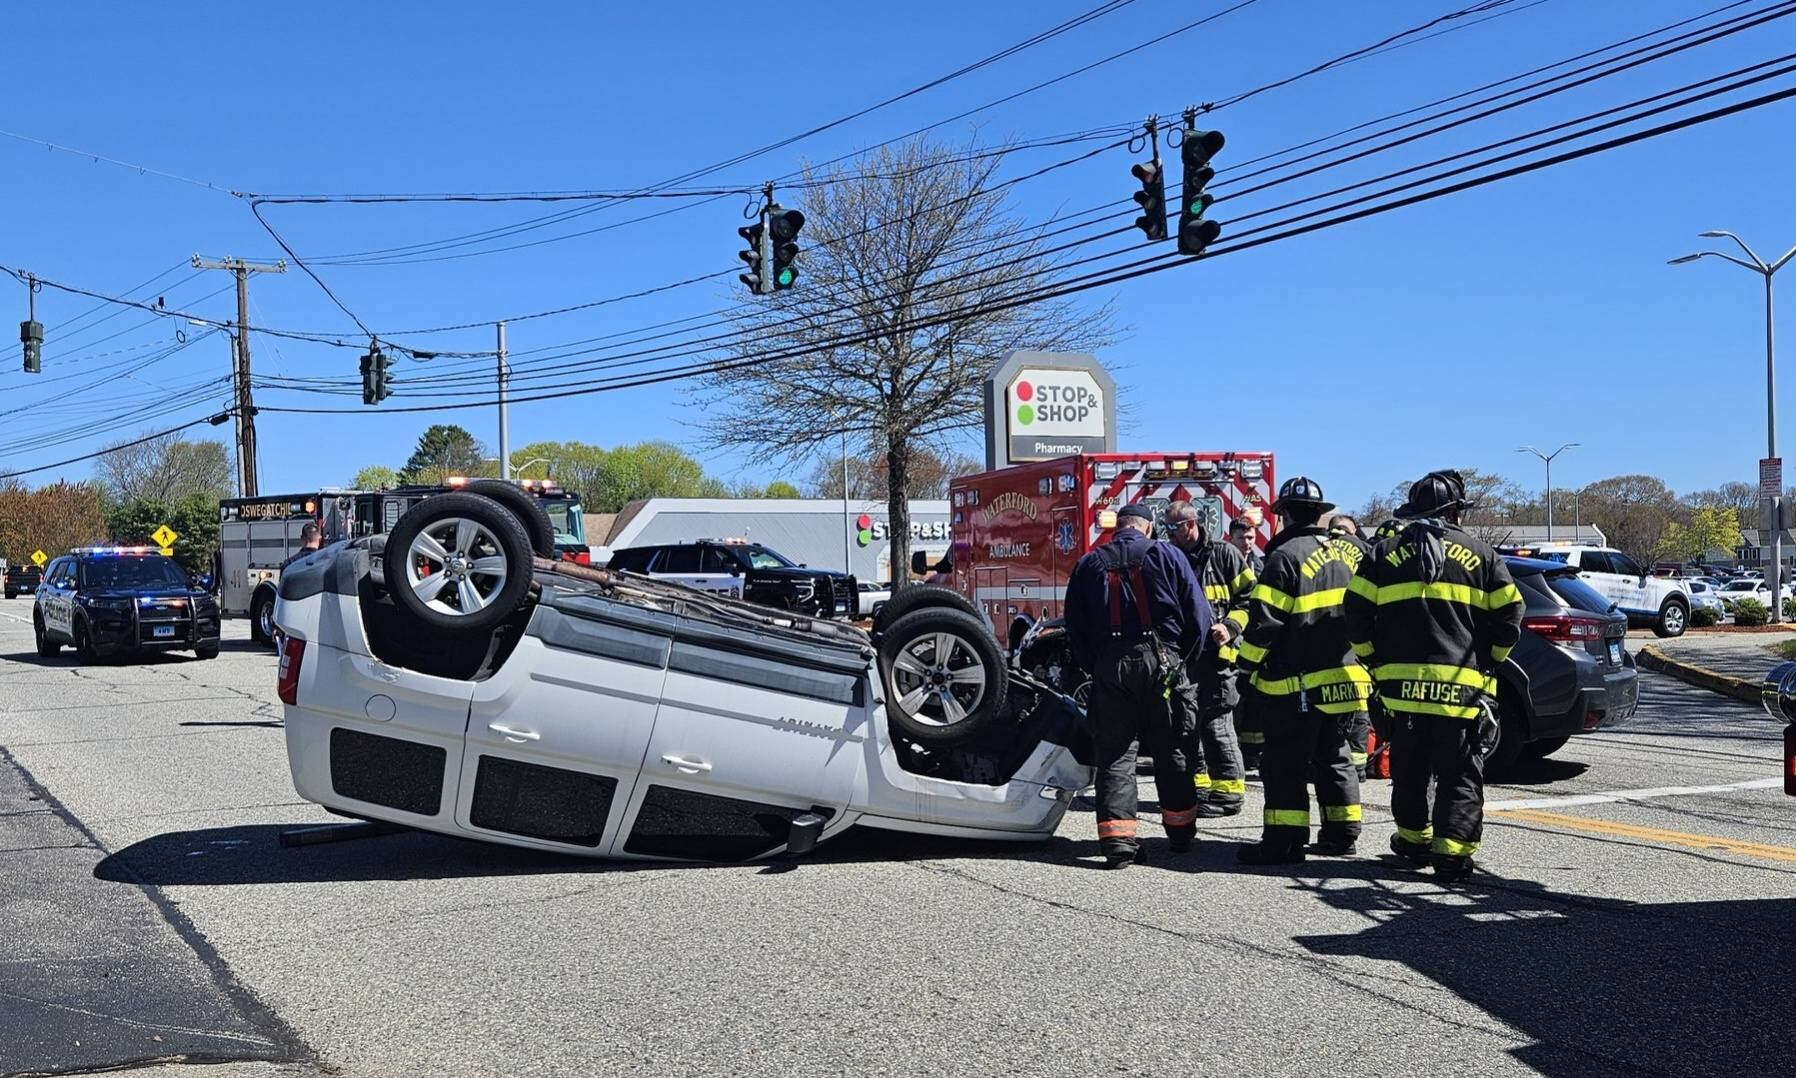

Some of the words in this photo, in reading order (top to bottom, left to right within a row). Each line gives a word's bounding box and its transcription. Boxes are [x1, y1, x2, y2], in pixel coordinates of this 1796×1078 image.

[1036, 385, 1088, 403] STOP
[1087, 393, 1098, 408] &
[1037, 404, 1089, 422] SHOP
[1034, 442, 1083, 454] Pharmacy
[983, 492, 1037, 521] WATERFORD
[989, 543, 1030, 558] AMBULANCE
[1385, 540, 1481, 572] WATFORD
[1401, 681, 1462, 704] RAFUSE
